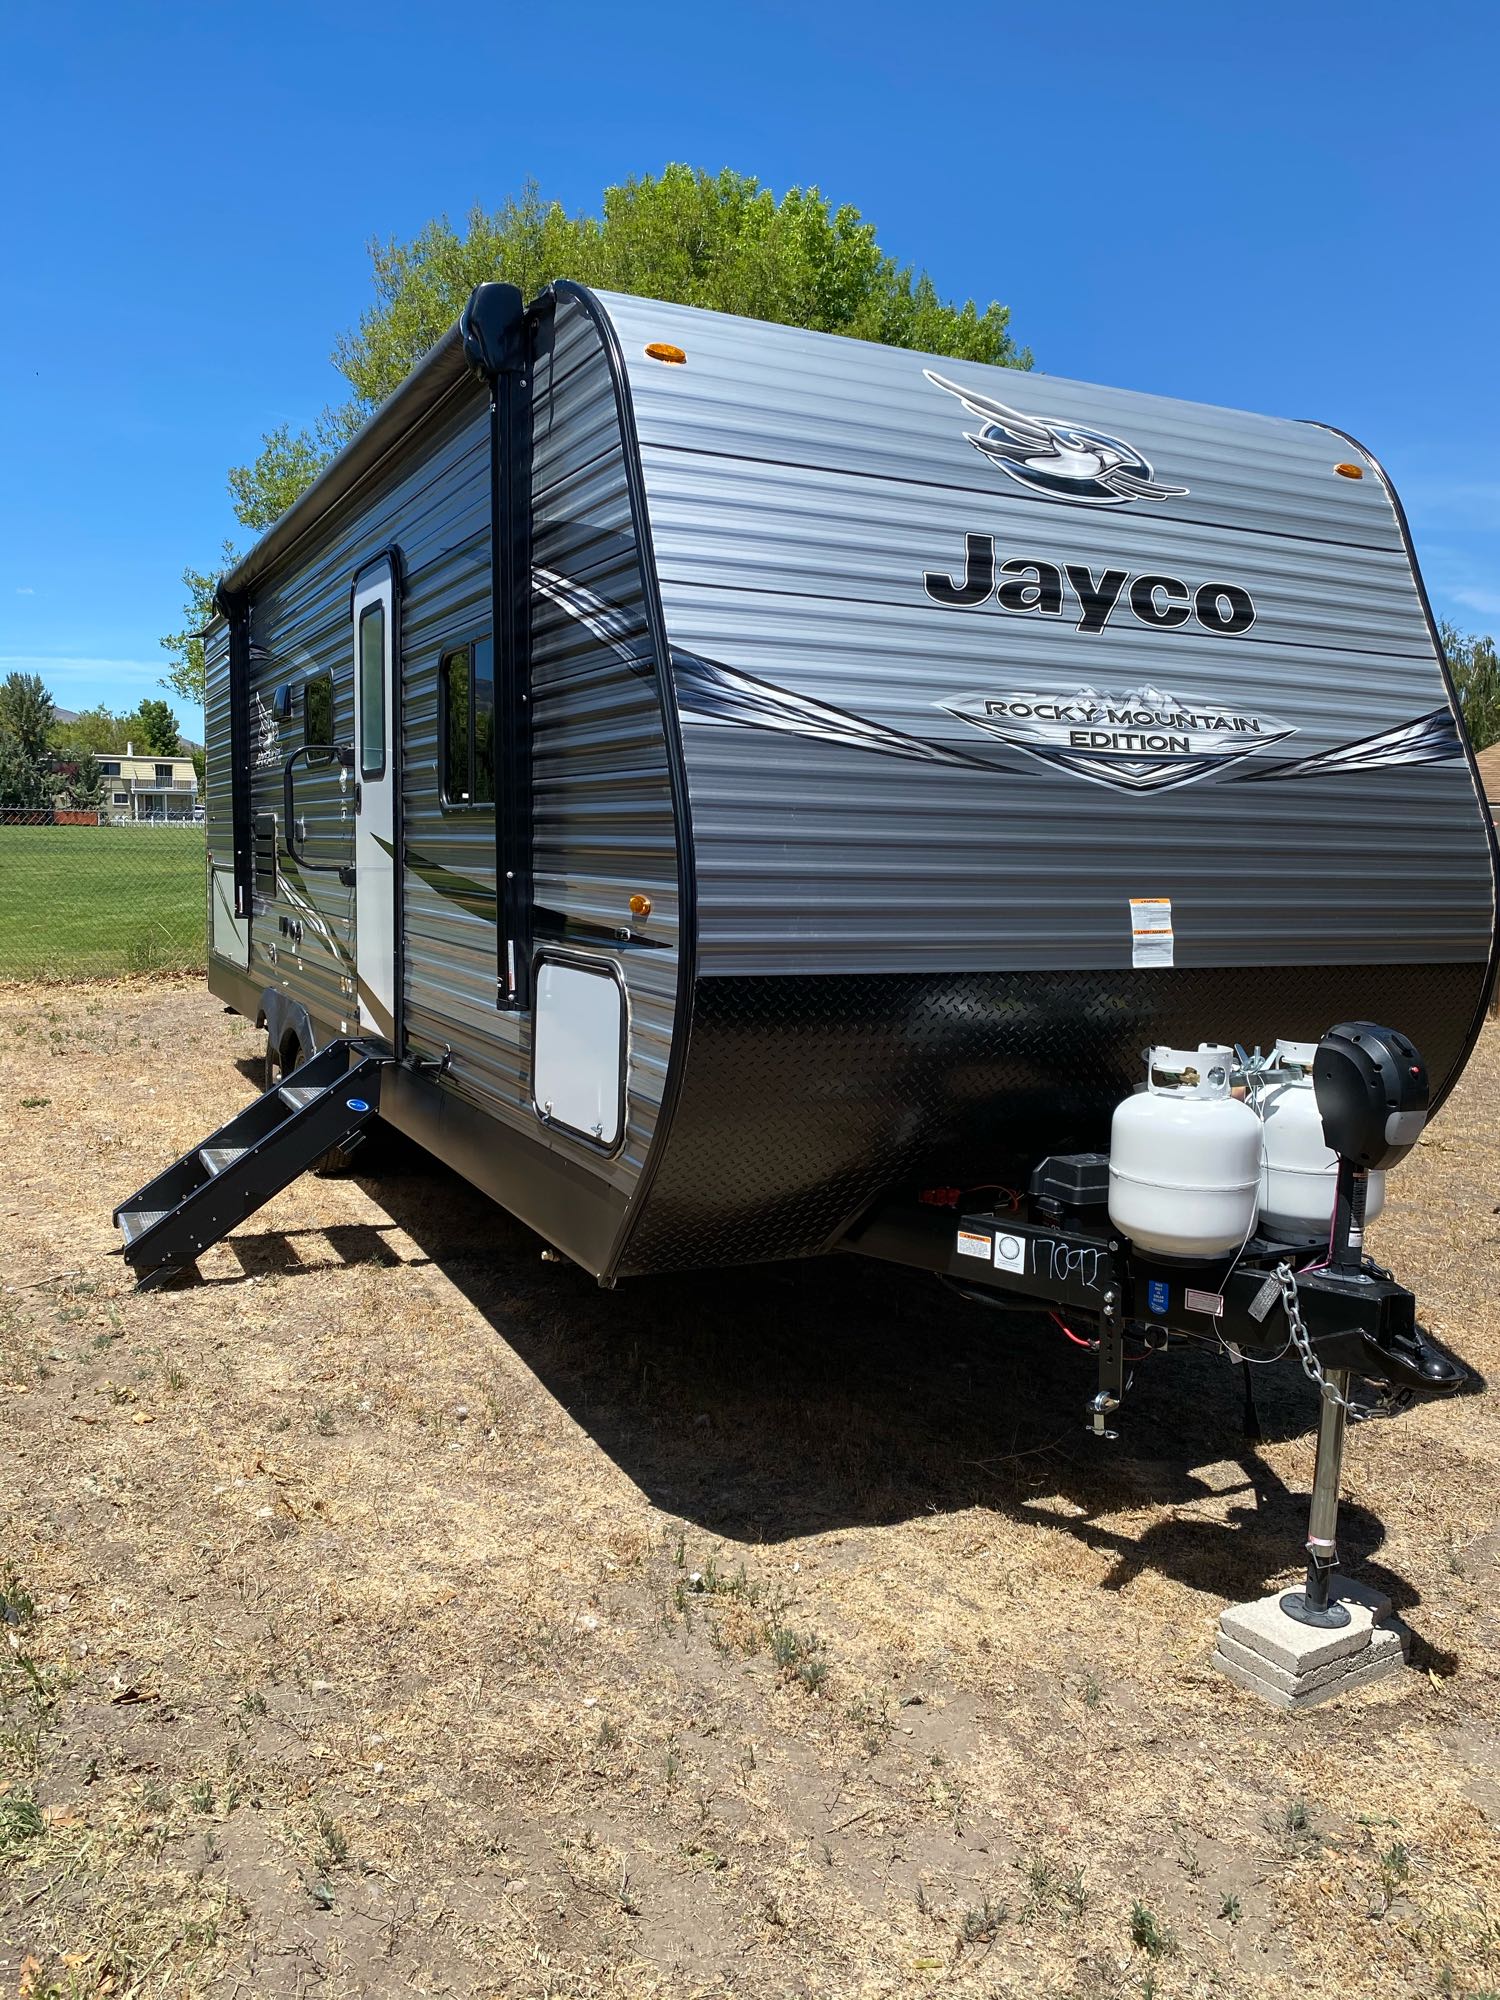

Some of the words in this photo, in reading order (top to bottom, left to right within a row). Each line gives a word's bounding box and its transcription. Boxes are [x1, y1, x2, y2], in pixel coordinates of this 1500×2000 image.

[923, 532, 1257, 635] Jayco
[984, 700, 1098, 722] ROCKY
[1108, 708, 1261, 733] MOUNTAIN
[1069, 730, 1191, 752] EDITION
